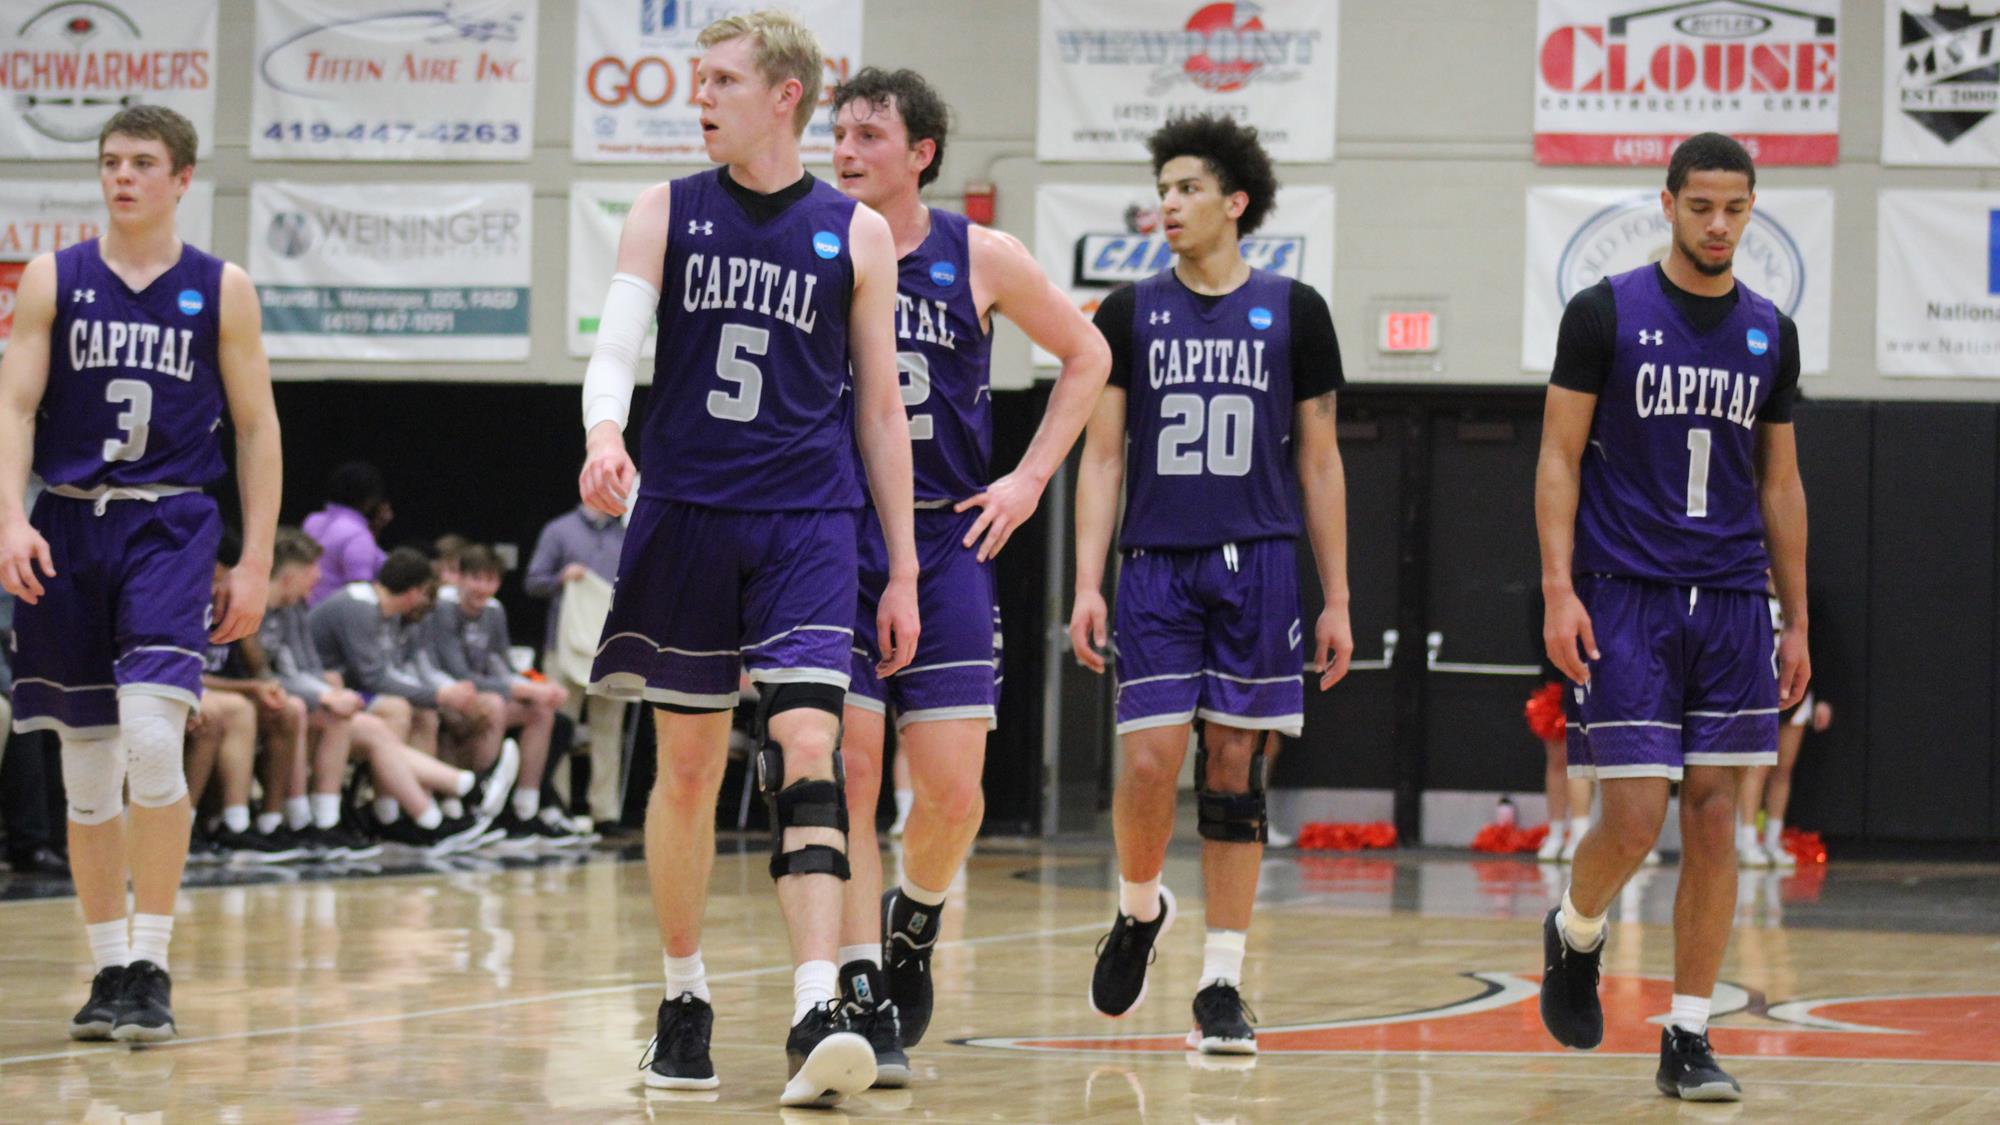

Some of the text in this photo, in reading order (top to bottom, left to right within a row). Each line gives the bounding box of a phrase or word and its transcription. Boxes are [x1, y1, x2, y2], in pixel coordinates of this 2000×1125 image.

[1056, 30, 1313, 65] VIEWPOINT
[1541, 26, 1836, 93] CLOUSE
[586, 56, 676, 107] GO
[1541, 98, 1741, 112] CONSTRUCTION
[264, 122, 521, 143] 419-447-4263
[318, 209, 521, 246] WEININGER
[1620, 212, 1669, 244] FOR
[683, 253, 818, 335] CAPITAL
[69, 318, 195, 382] CAPITAL
[1388, 311, 1431, 350] EXIT
[706, 323, 770, 422] 5
[1148, 338, 1269, 392] CAPITAL
[103, 378, 153, 462] 3
[1635, 361, 1760, 430] CAPITAL
[1157, 393, 1255, 477] 20
[1686, 428, 1711, 517] 1
